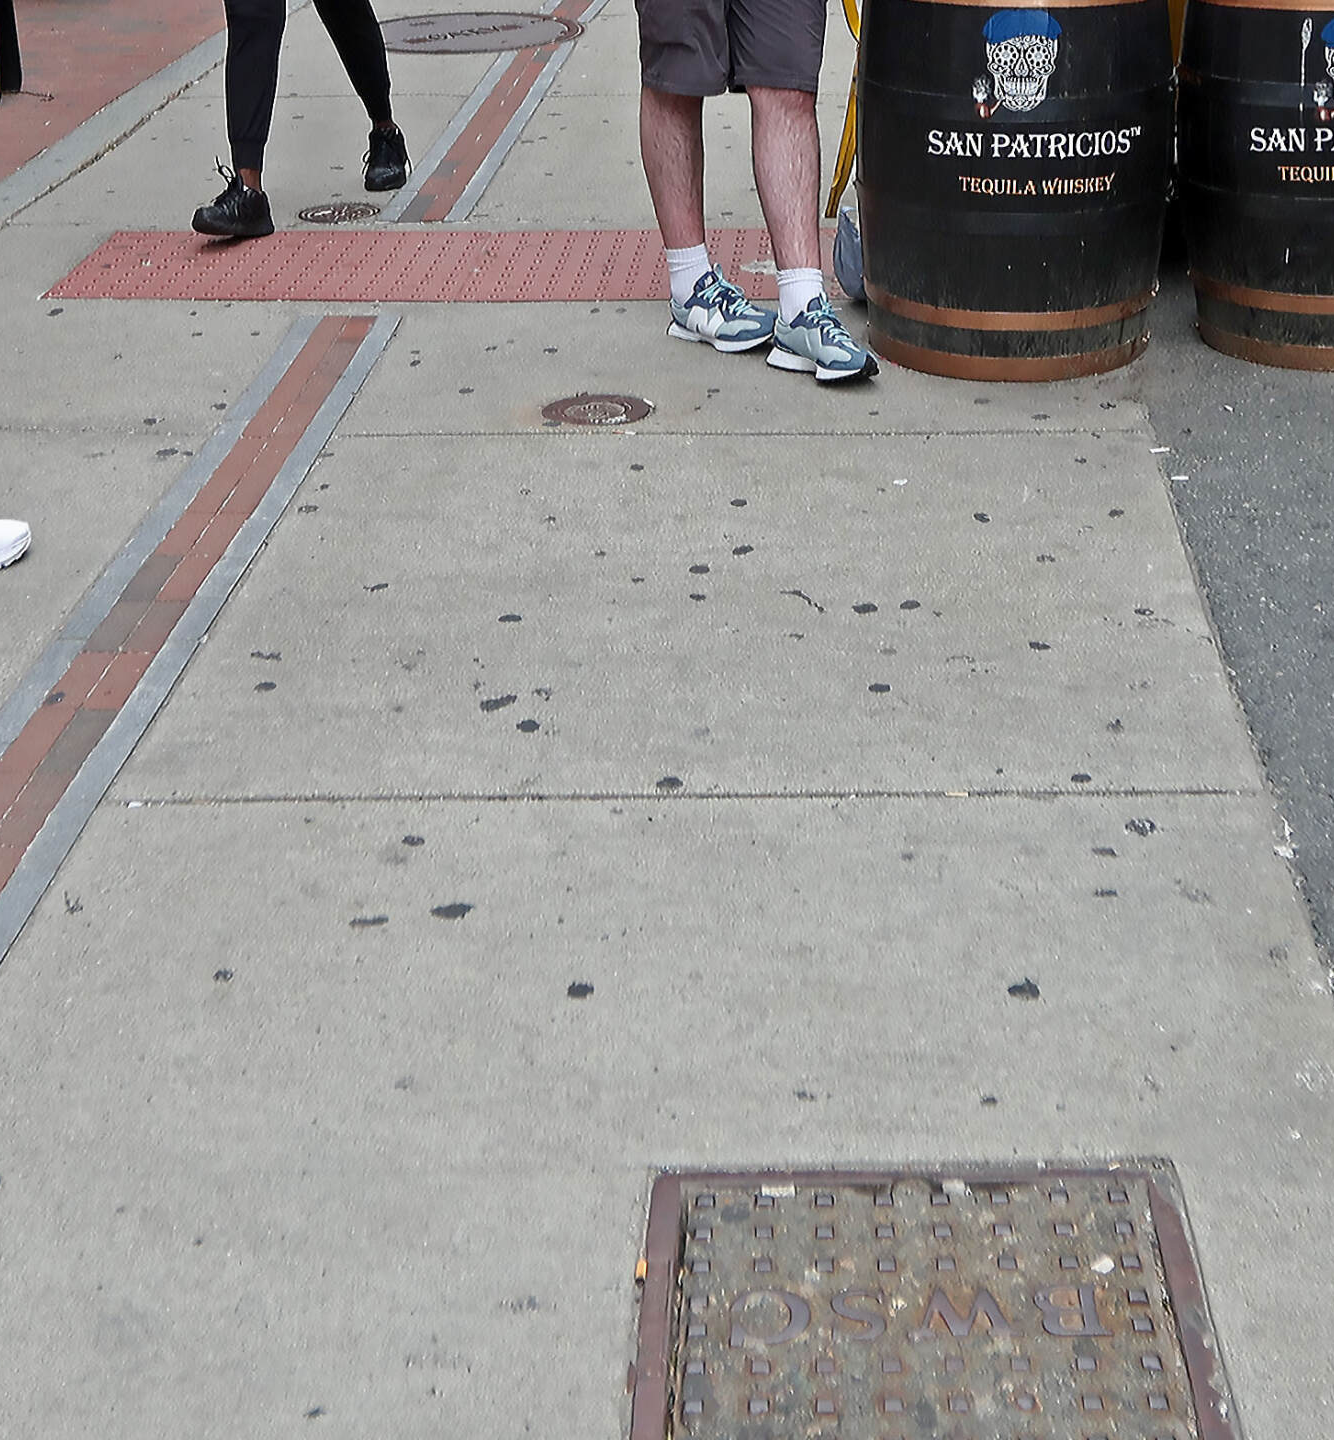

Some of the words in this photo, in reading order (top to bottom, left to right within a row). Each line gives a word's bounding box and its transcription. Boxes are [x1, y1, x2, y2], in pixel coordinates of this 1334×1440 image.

[927, 130, 983, 158] SAN
[1249, 127, 1306, 152] SAN
[958, 175, 1038, 196] TEQUILA
[1041, 172, 1116, 195] WHISKEY
